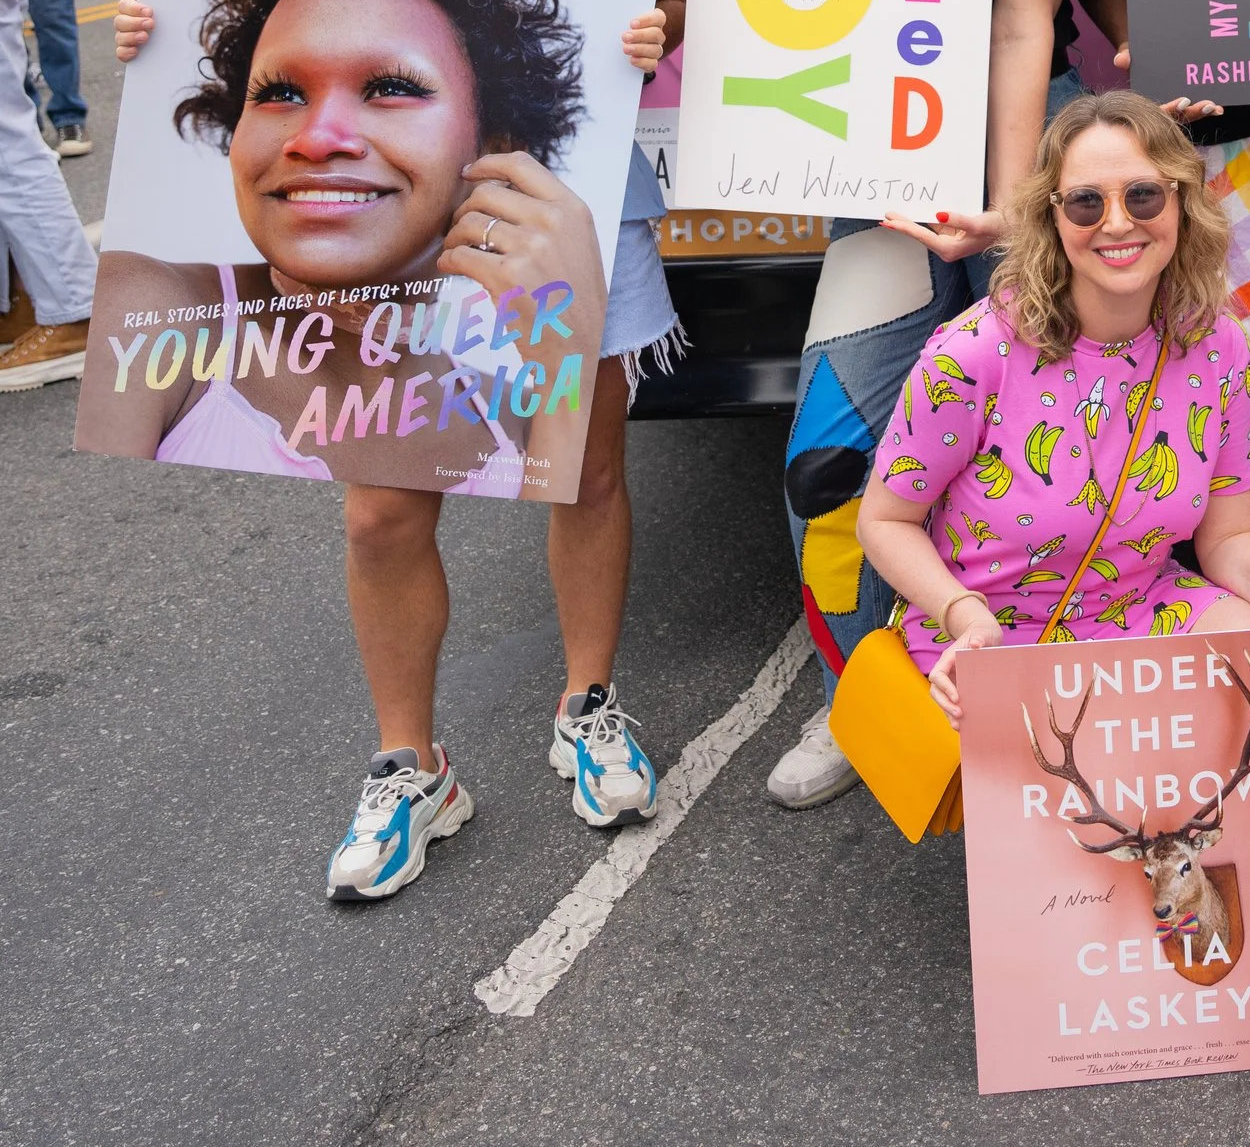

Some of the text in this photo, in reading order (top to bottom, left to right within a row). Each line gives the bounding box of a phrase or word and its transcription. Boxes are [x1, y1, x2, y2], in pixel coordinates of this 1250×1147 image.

[1210, 0, 1239, 38] MY
[124, 277, 454, 329] REAL STORIES AND FACES OF LGBTQ+ YOUTH
[107, 280, 576, 393] YOUNG QUEER
[286, 353, 585, 447] AMERICA
[435, 466, 549, 487] Foreword by Isis King
[477, 452, 551, 468] Maxwell Poth
[1054, 654, 1233, 700] UNDER
[1094, 714, 1196, 754] THE
[1041, 884, 1116, 915] A Novel
[1077, 931, 1232, 976] CELIA
[1086, 1052, 1102, 1060] with
[1103, 1050, 1120, 1058] such
[1121, 1046, 1158, 1057] conviction
[1159, 1045, 1173, 1053] and
[1174, 1044, 1192, 1053] grace
[1205, 1040, 1223, 1049] fresh
[1106, 1062, 1128, 1072] New
[1129, 1059, 1153, 1071] York
[1156, 1059, 1181, 1068] Times
[1184, 1056, 1203, 1065] Book
[1206, 1053, 1239, 1063] Review
